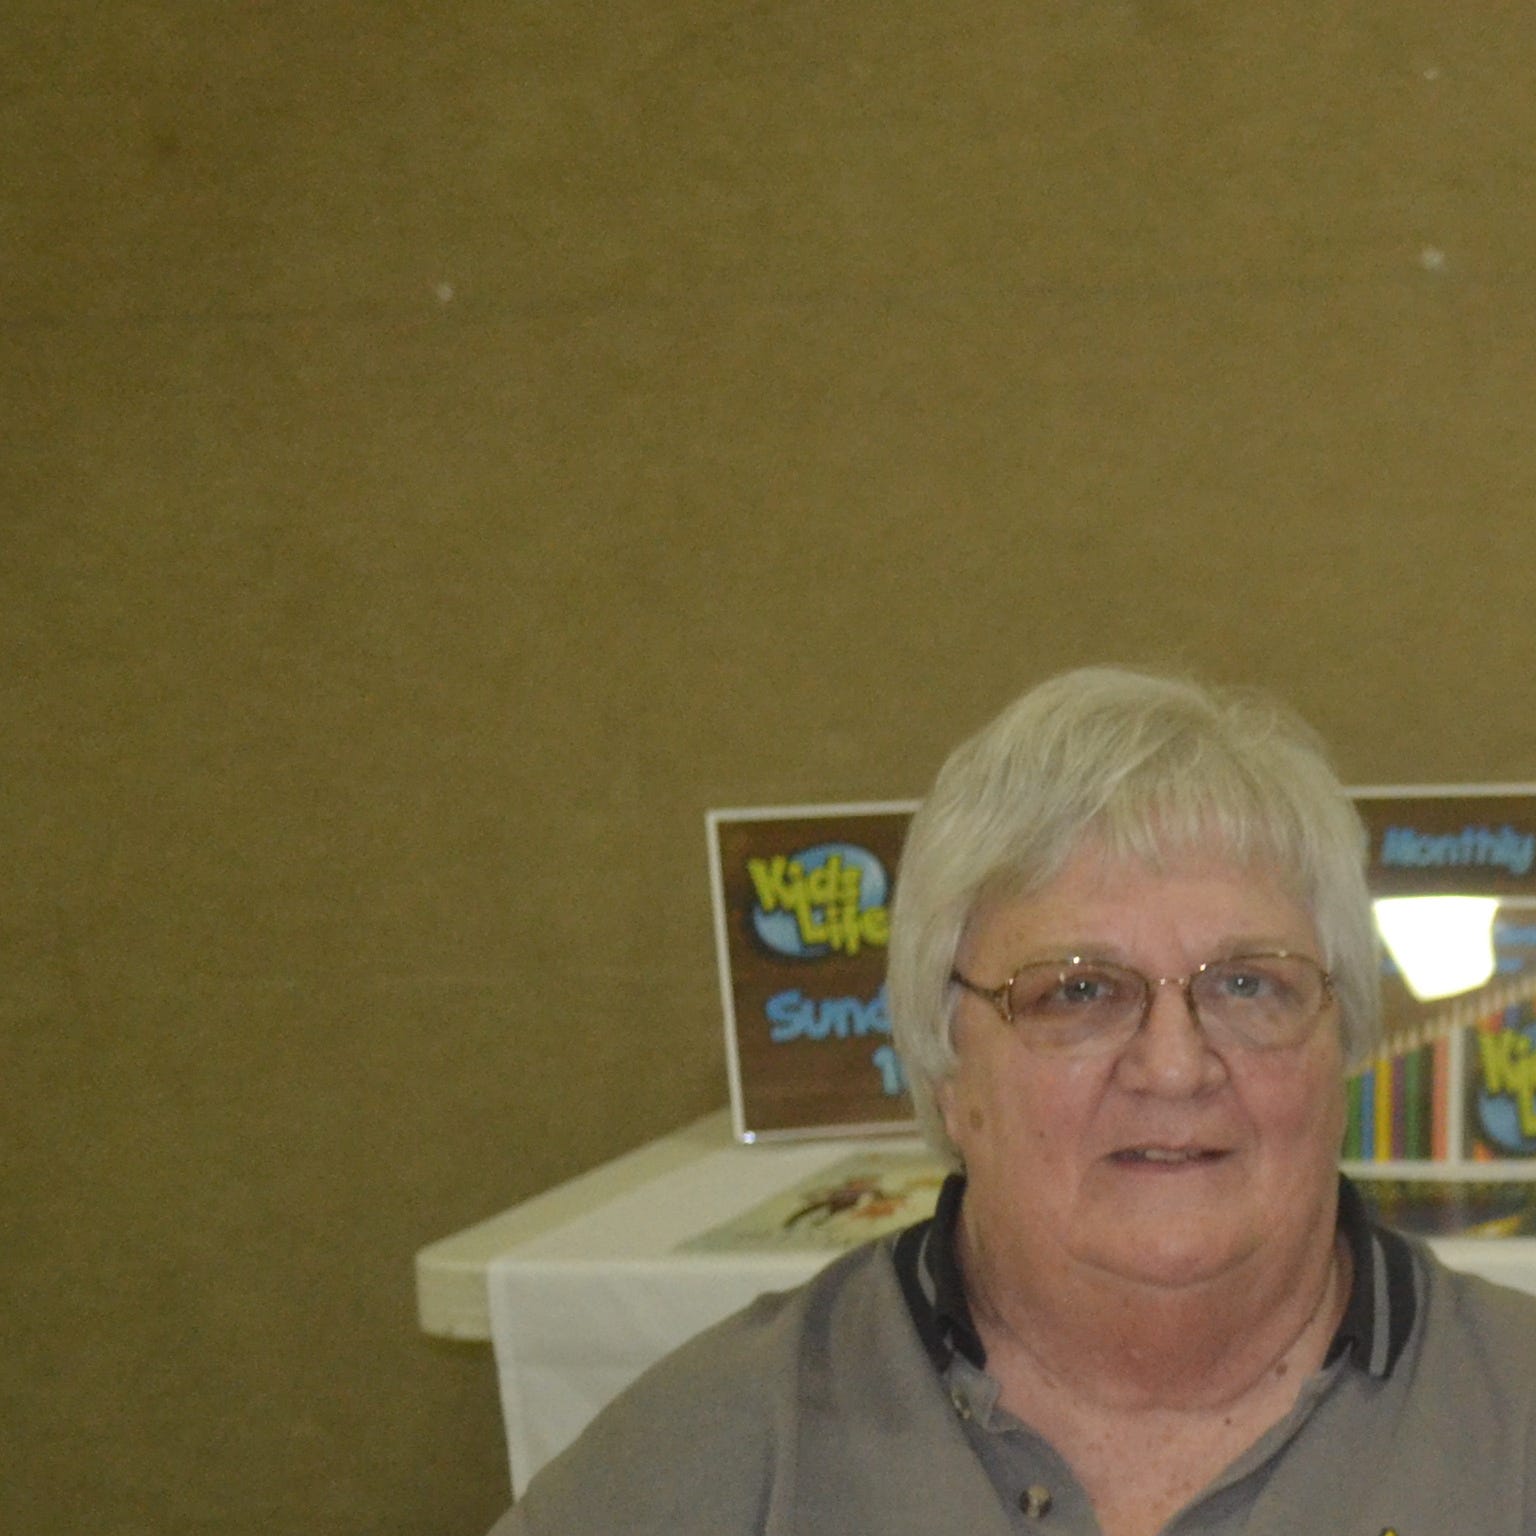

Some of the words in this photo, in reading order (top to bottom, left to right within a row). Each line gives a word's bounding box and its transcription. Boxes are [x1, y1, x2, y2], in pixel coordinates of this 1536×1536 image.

[1381, 824, 1536, 875] Monthly
[747, 853, 863, 911] Kids
[798, 899, 889, 955] Life
[765, 984, 892, 1042] Sund
